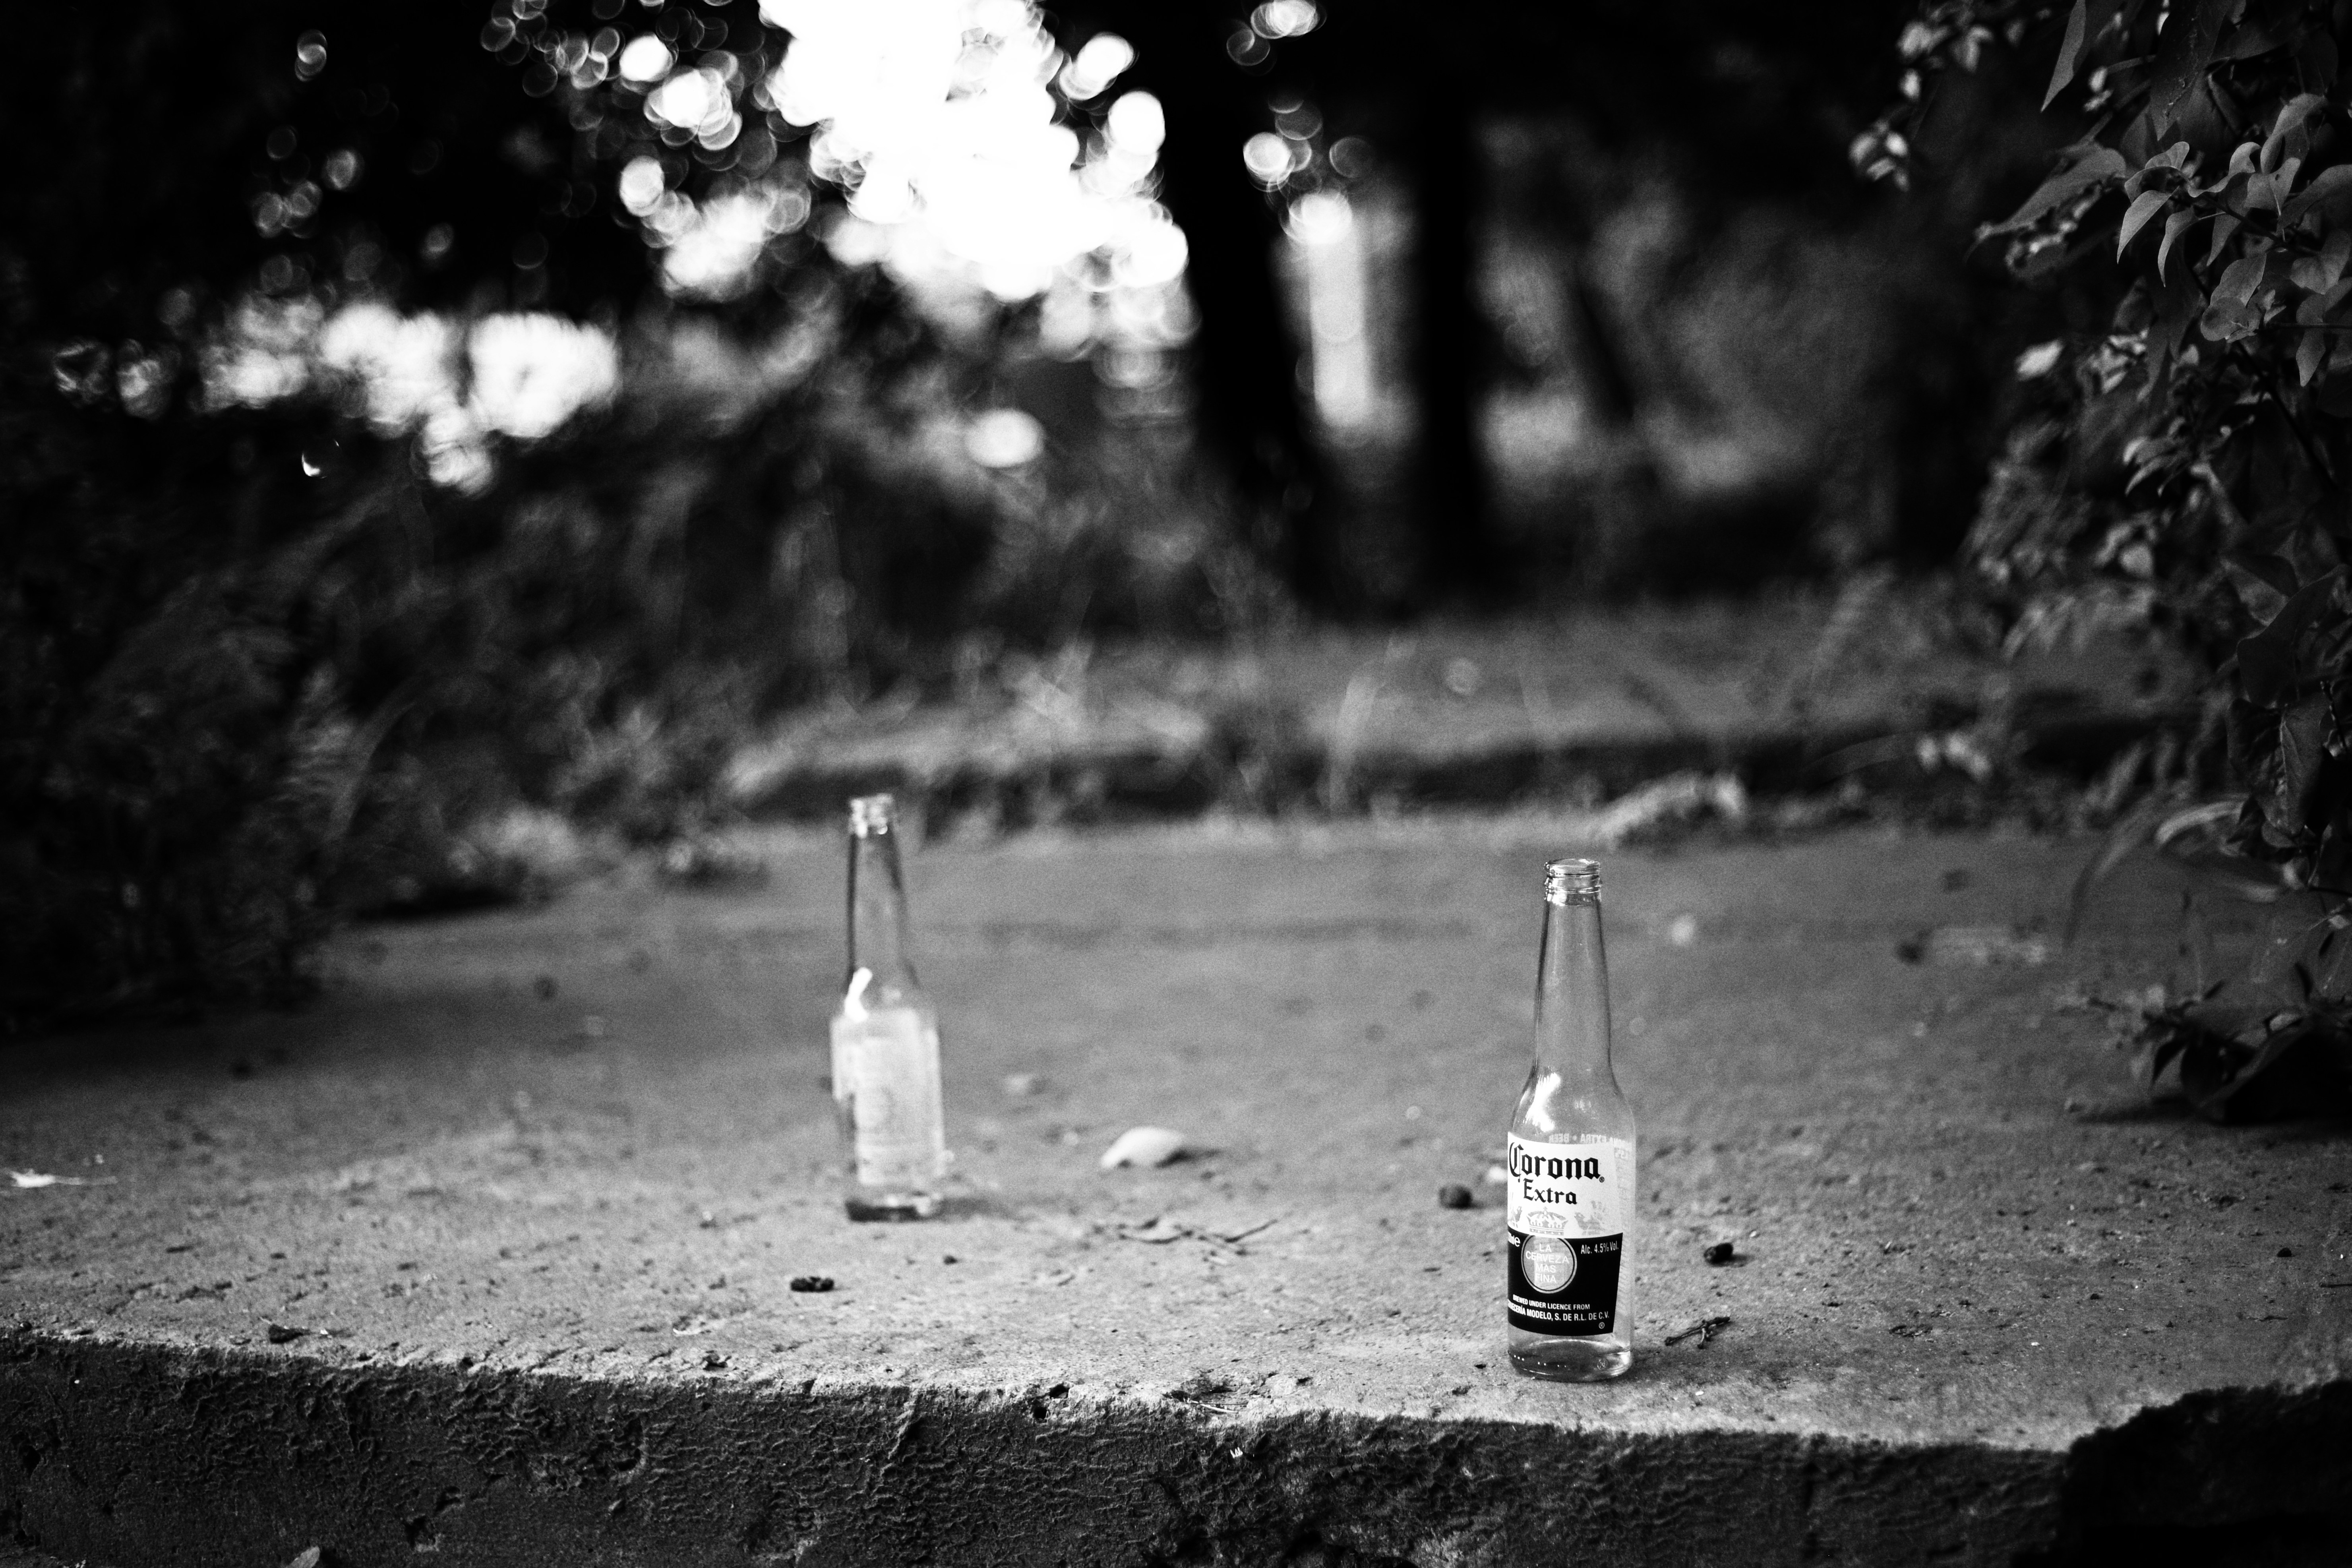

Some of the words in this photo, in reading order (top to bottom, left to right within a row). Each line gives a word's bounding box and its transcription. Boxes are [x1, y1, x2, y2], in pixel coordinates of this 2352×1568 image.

[1509, 1142, 1601, 1183] Corona
[1523, 1178, 1578, 1204] Extra
[1539, 1243, 1552, 1252] LA
[1581, 1244, 1592, 1254] Alc.
[1594, 1243, 1609, 1253] 4.5%
[1610, 1241, 1619, 1251] Vol.
[1525, 1251, 1569, 1264] CERVEZA
[1535, 1263, 1556, 1273] MAS
[1535, 1273, 1557, 1283] FINA
[1513, 1294, 1528, 1305] BREWED
[1529, 1300, 1546, 1309] UNDER
[1527, 1309, 1553, 1321] MODELO,
[1563, 1313, 1572, 1321] DE
[1599, 1311, 1609, 1320] C.V.
